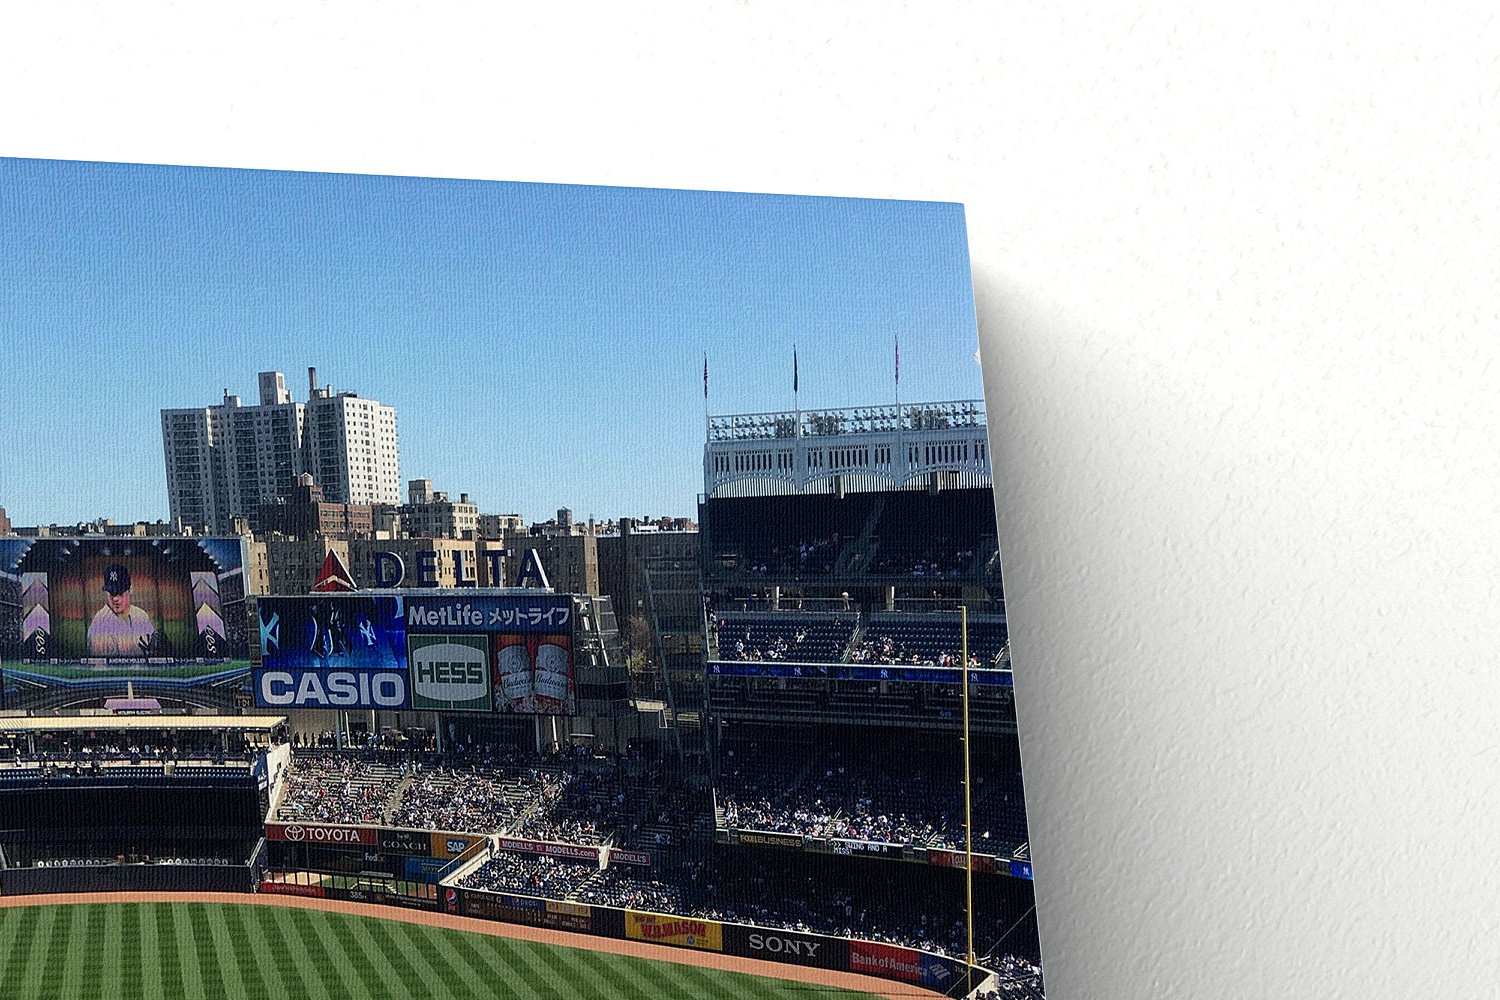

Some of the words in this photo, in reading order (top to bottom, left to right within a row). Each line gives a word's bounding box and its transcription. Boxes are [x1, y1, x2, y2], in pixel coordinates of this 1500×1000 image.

[374, 548, 550, 589] DELTA
[408, 603, 483, 626] MetLife
[489, 607, 570, 626] メットライフ
[416, 661, 483, 684] HESS
[261, 671, 405, 706] CASIO
[306, 828, 361, 842] TOYOTA
[382, 839, 427, 852] COACH
[446, 840, 466, 853] SAP
[502, 840, 534, 851] MODELL'S
[545, 844, 595, 858] MODELLS.com
[613, 852, 647, 863] MODELL'S
[749, 933, 821, 958] SONY
[852, 951, 879, 966] Bank
[878, 954, 890, 967] of
[890, 957, 928, 977] America
